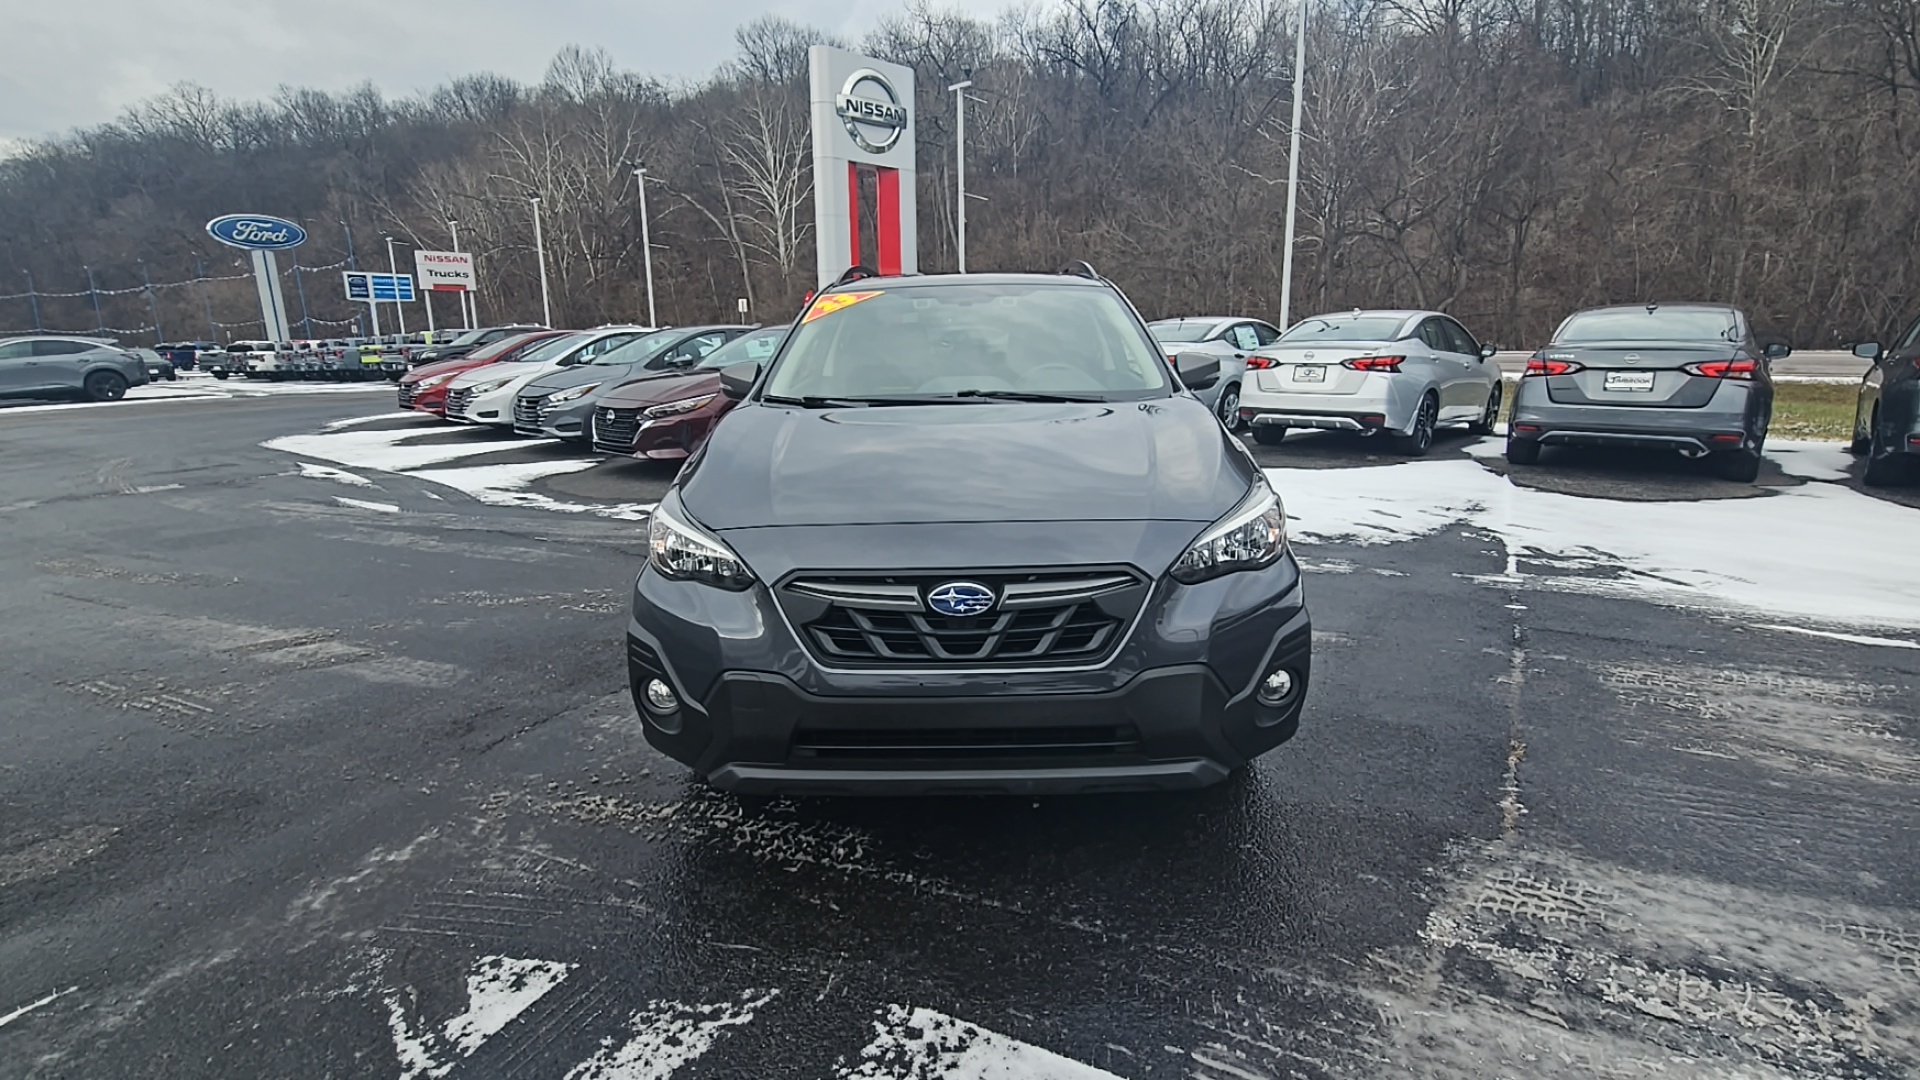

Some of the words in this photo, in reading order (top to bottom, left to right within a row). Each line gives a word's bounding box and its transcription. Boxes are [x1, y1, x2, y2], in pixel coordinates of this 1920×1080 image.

[846, 98, 904, 122] NISSAN
[232, 221, 289, 242] Ford
[424, 255, 468, 263] NISSAN
[427, 269, 469, 278] Trucks
